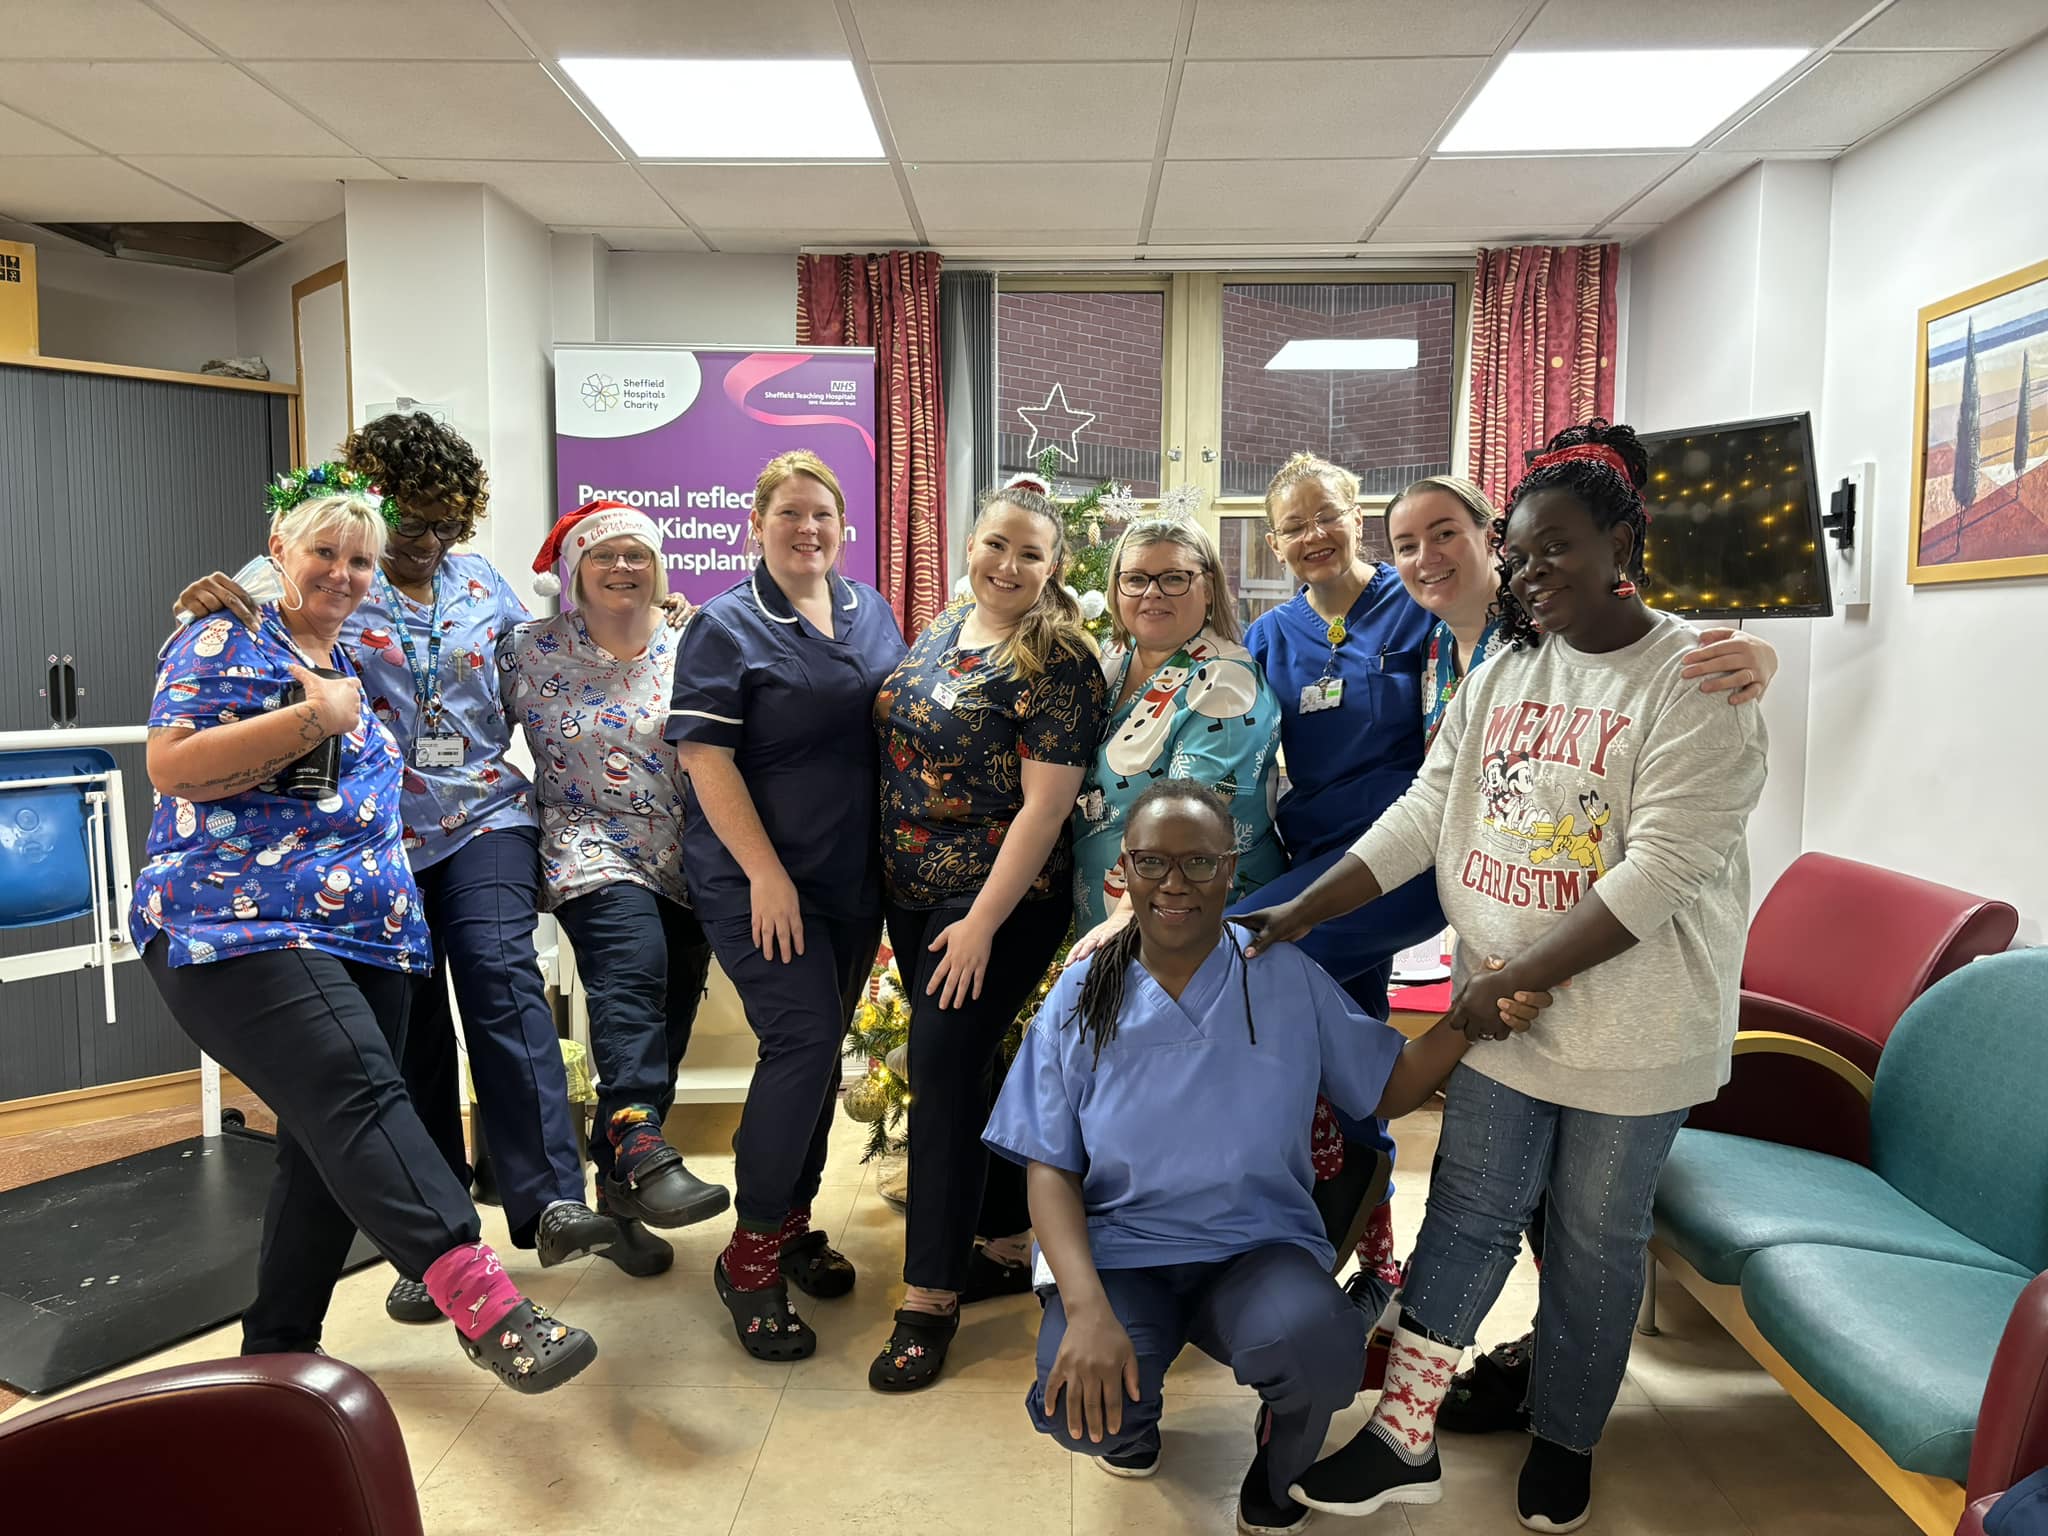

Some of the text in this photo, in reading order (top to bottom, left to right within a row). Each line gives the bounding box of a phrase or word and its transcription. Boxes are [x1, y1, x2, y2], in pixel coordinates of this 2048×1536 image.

[623, 378, 665, 388] Sheffield
[832, 382, 855, 391] NHS
[623, 389, 666, 401] Hospitals
[764, 391, 856, 401] Sheffield Teaching Hospitals
[623, 400, 659, 411] Charity
[578, 484, 680, 508] Personal
[658, 516, 741, 546] Kidney
[660, 547, 763, 576] ansplant
[1484, 700, 1632, 778] MERRY
[1461, 849, 1600, 912] CHRISTM
